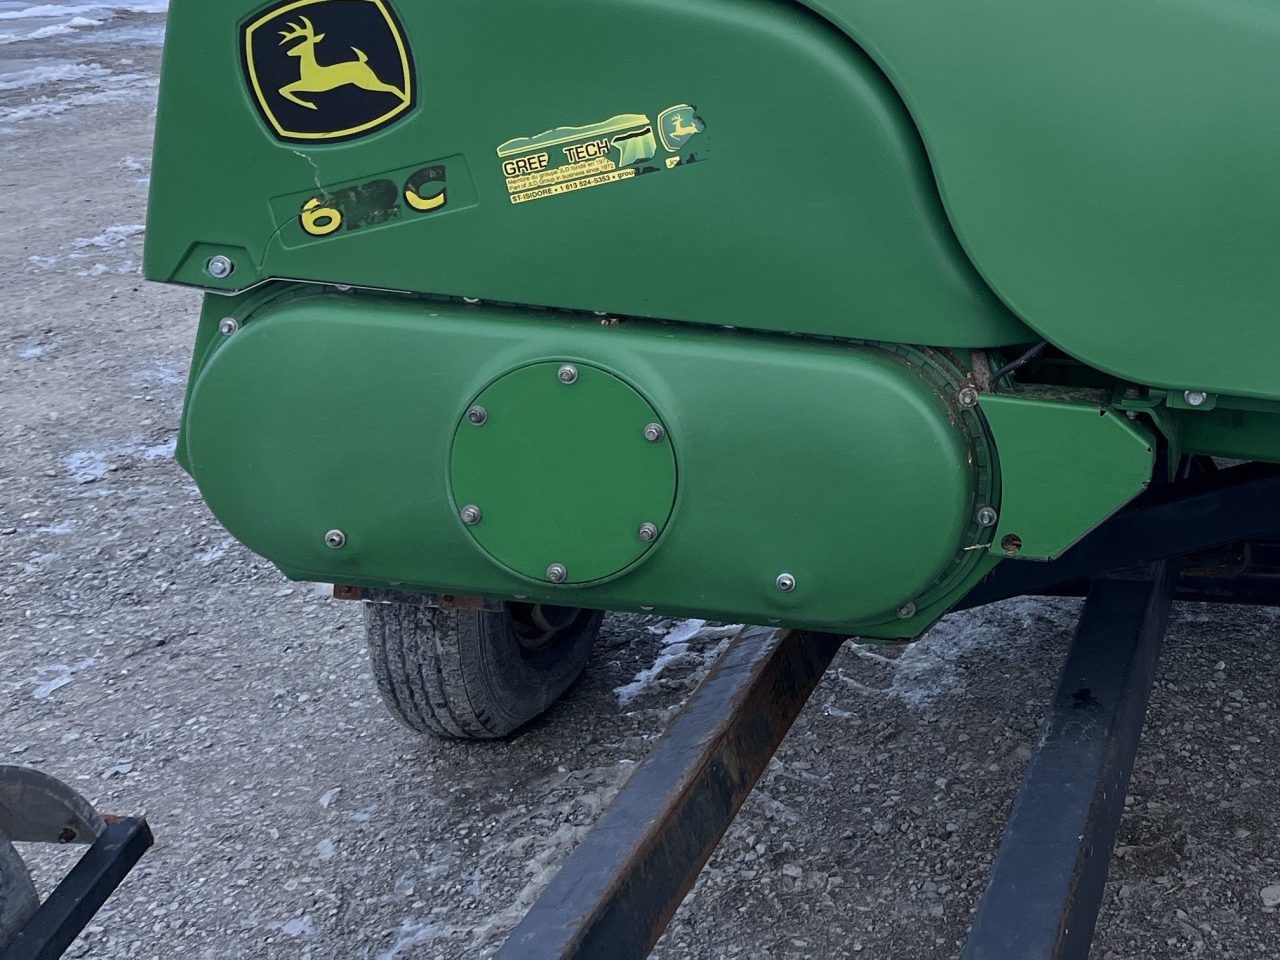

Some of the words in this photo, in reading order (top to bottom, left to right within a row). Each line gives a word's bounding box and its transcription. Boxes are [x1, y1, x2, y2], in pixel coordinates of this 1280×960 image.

[564, 140, 610, 163] TECH
[511, 188, 552, 202] ST-ISIDORE
[578, 174, 611, 187] 524-5353
